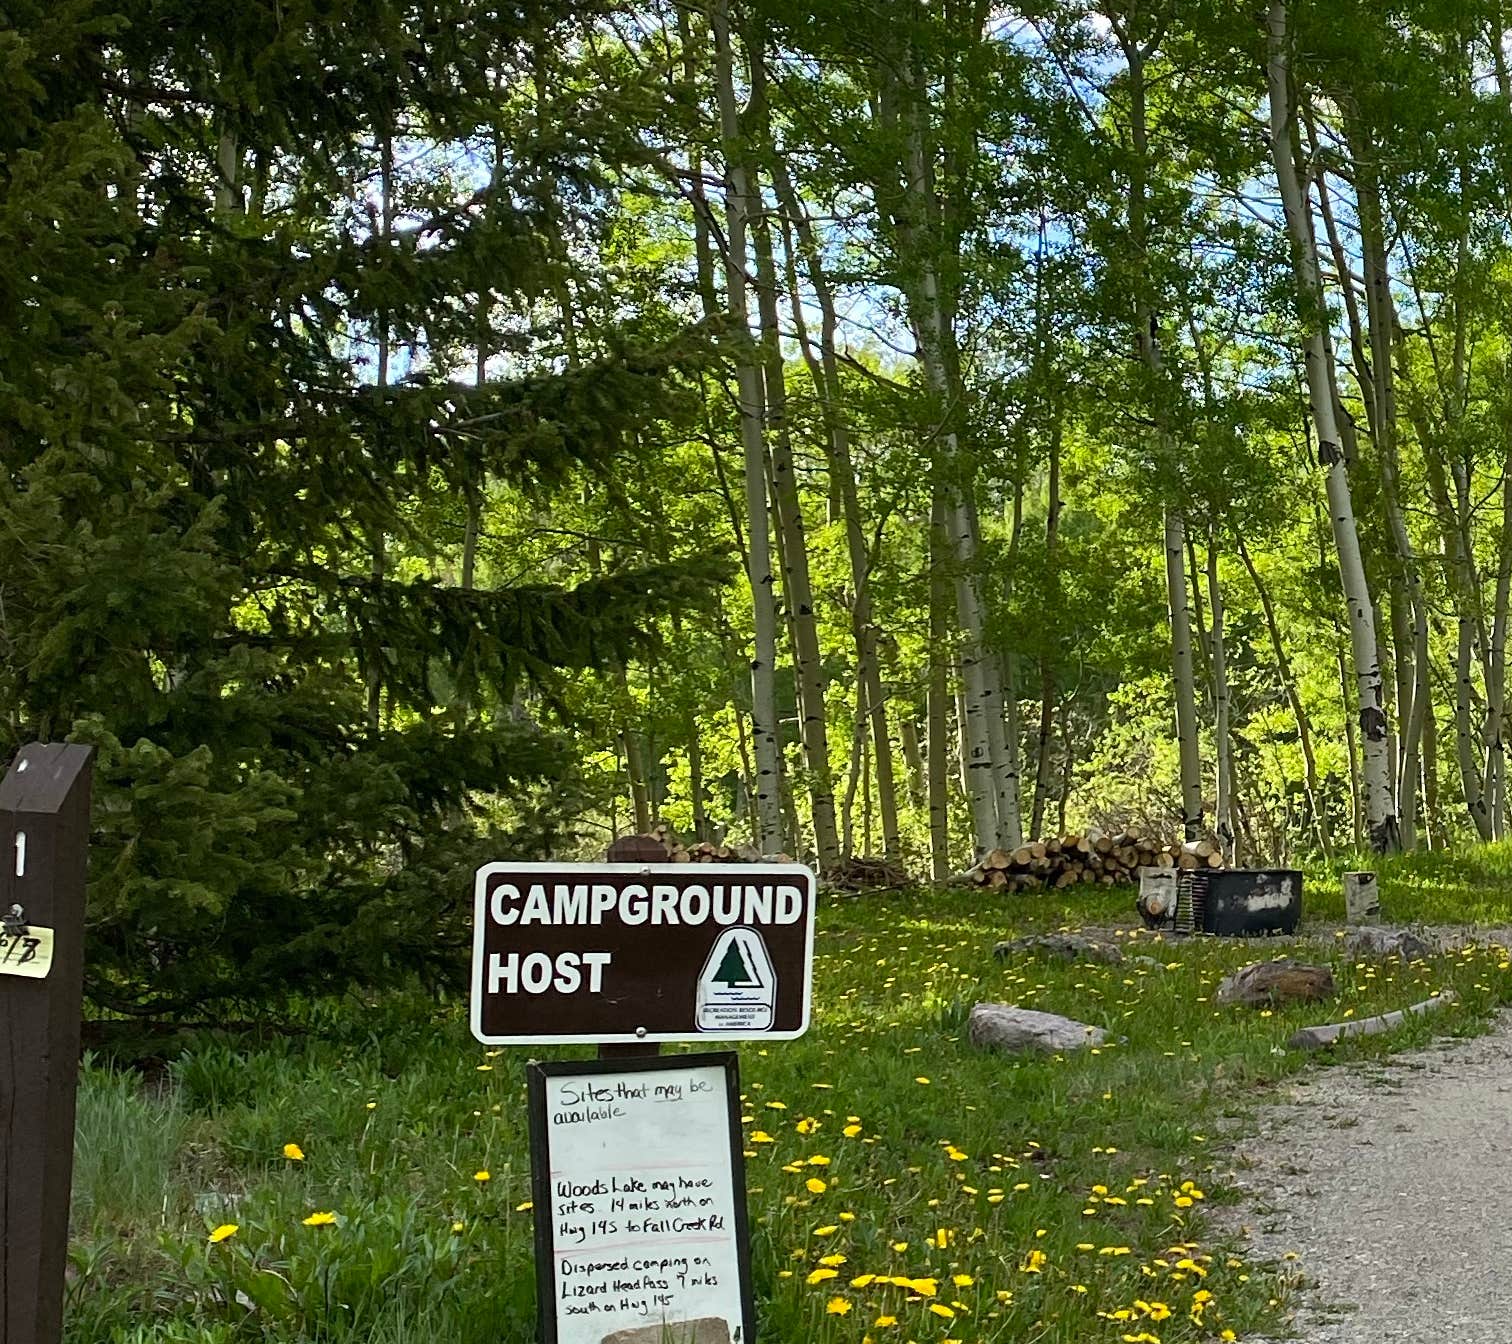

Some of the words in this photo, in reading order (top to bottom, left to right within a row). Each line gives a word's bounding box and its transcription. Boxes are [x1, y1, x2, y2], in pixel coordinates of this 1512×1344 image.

[490, 884, 803, 926] CAMPGROUND
[487, 952, 611, 994] HOST
[560, 1081, 614, 1105] Sites
[614, 1082, 650, 1100] that
[655, 1085, 683, 1102] may
[689, 1079, 713, 1093] be
[553, 1104, 626, 1125] available
[557, 1180, 608, 1198] Woods
[612, 1176, 647, 1193] Lake
[652, 1179, 677, 1200] may
[678, 1176, 713, 1189] have
[611, 1198, 625, 1212] 14
[699, 1197, 714, 1207] on
[592, 1220, 618, 1235] 145
[625, 1220, 641, 1233] to
[643, 1218, 671, 1233] Fall
[672, 1217, 706, 1231] Creek
[709, 1214, 725, 1231] Rd
[561, 1256, 629, 1277] Dispersed
[694, 1257, 712, 1267] on
[561, 1280, 607, 1300] Lizard
[613, 1278, 640, 1293] Head
[643, 1275, 669, 1290] Pass
[604, 1304, 616, 1312] on
[653, 1293, 675, 1306] 145
